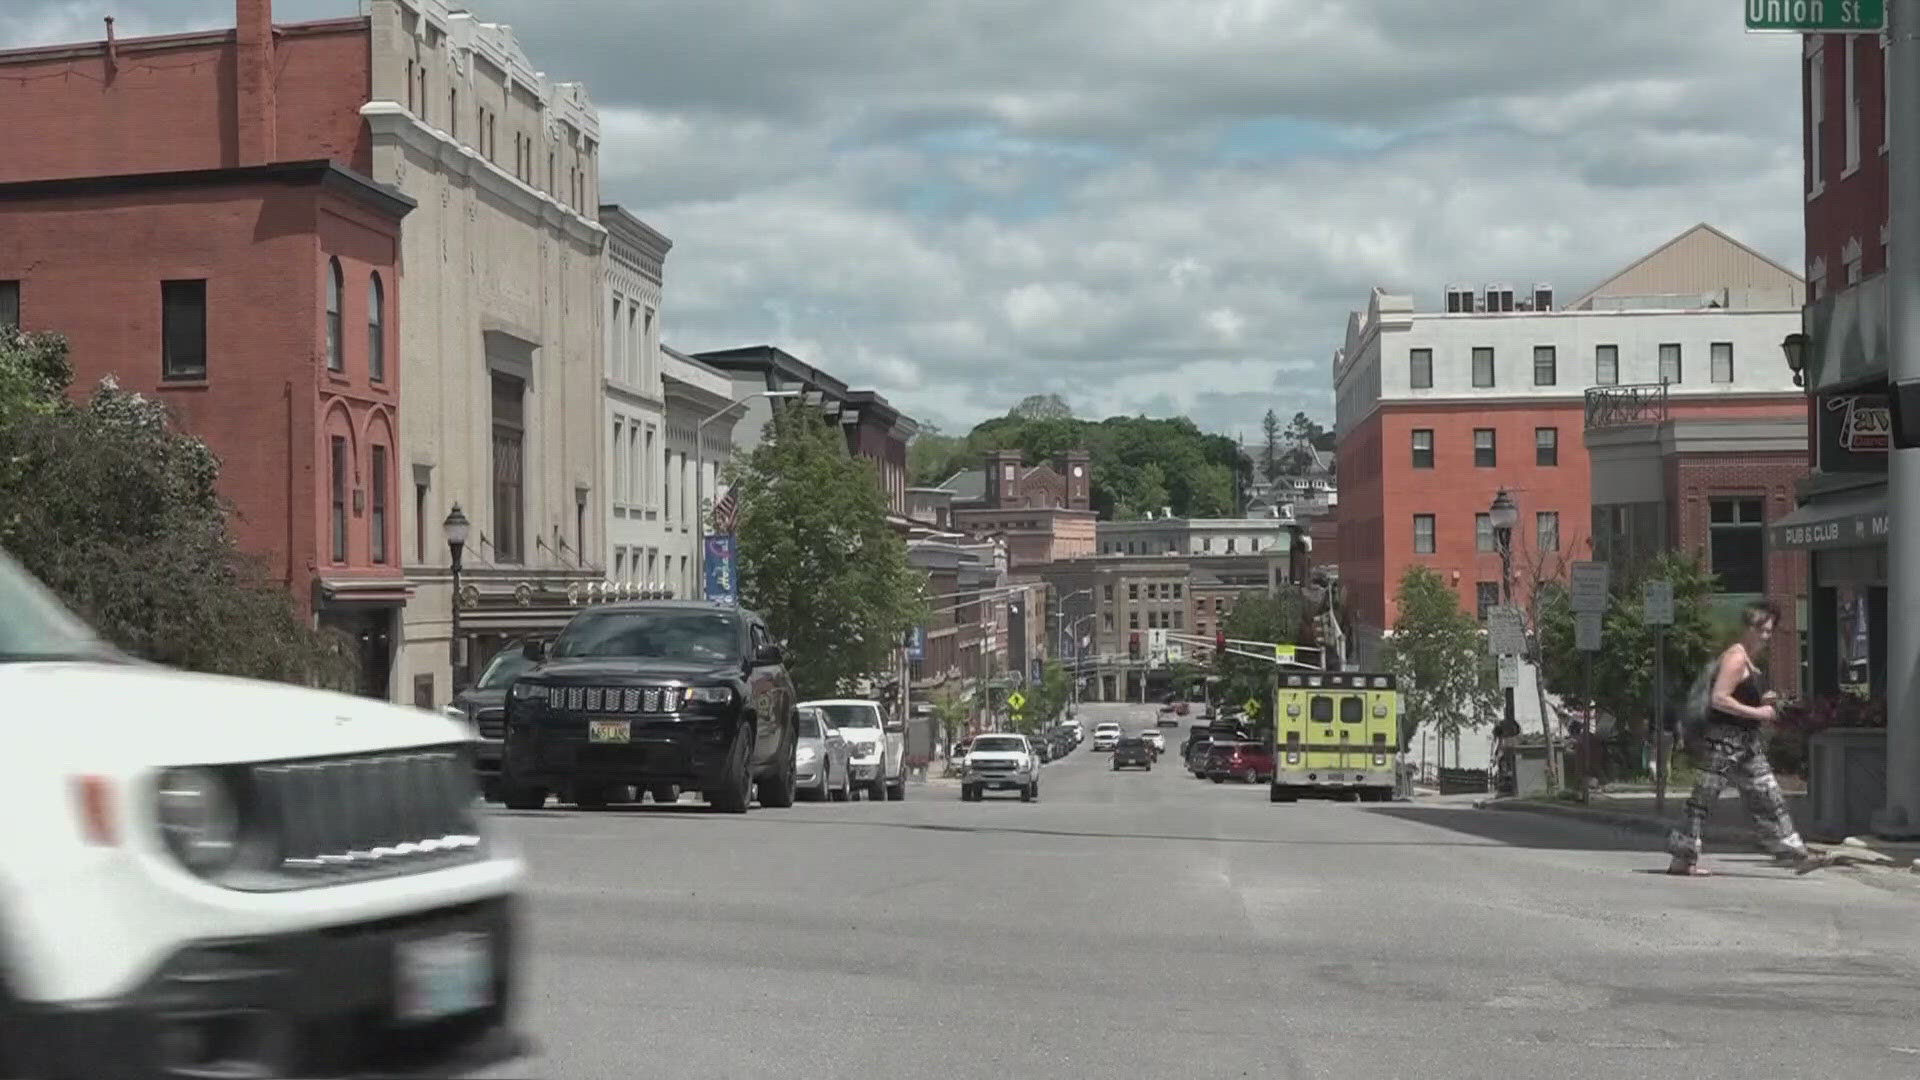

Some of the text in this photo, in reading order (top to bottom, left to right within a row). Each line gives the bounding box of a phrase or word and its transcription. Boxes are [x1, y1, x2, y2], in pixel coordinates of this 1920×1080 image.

[1750, 0, 1861, 23] Union St
[1827, 396, 1889, 448] Tav
[1785, 517, 1889, 544] PUB & CLUB MA
